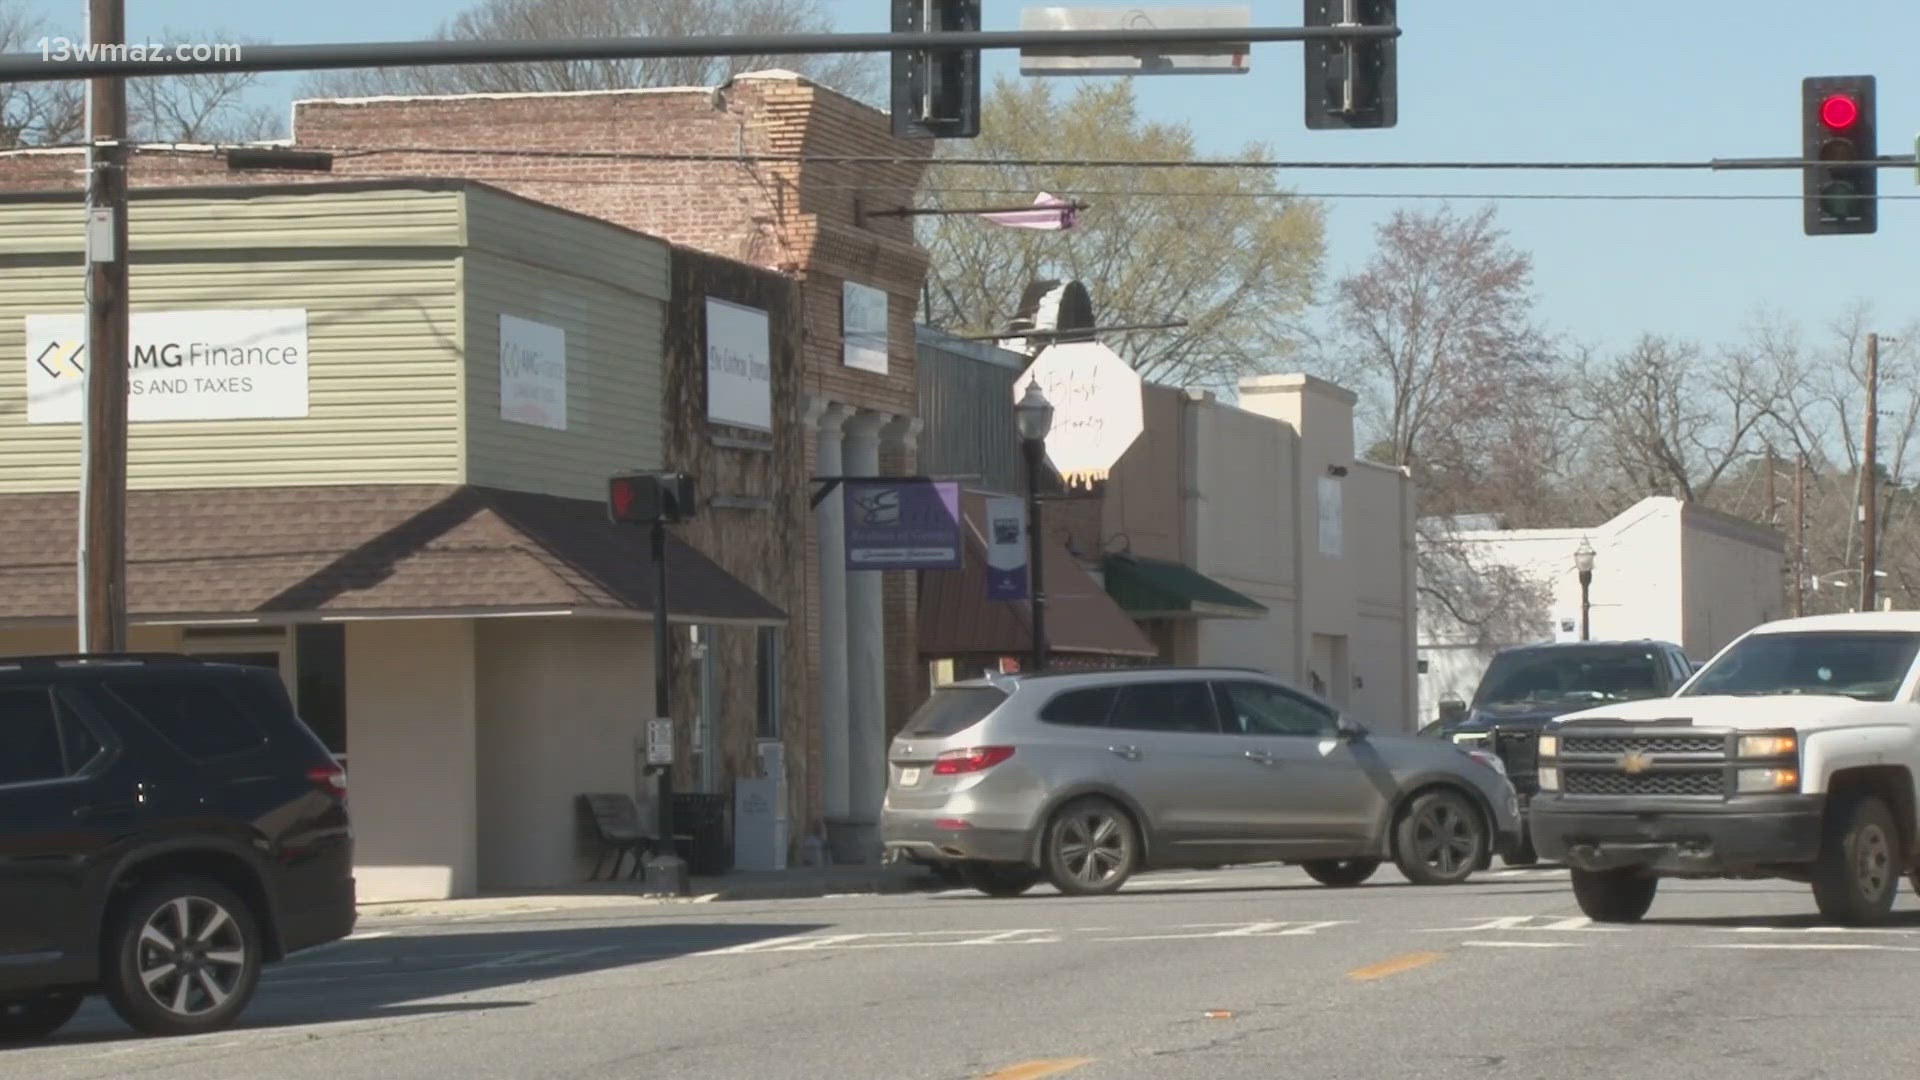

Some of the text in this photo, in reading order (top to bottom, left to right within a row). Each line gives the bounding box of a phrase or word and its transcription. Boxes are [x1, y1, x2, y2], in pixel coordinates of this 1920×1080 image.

[127, 343, 298, 369] MG Finance
[148, 379, 188, 395] AND
[194, 377, 253, 394] TAXES
